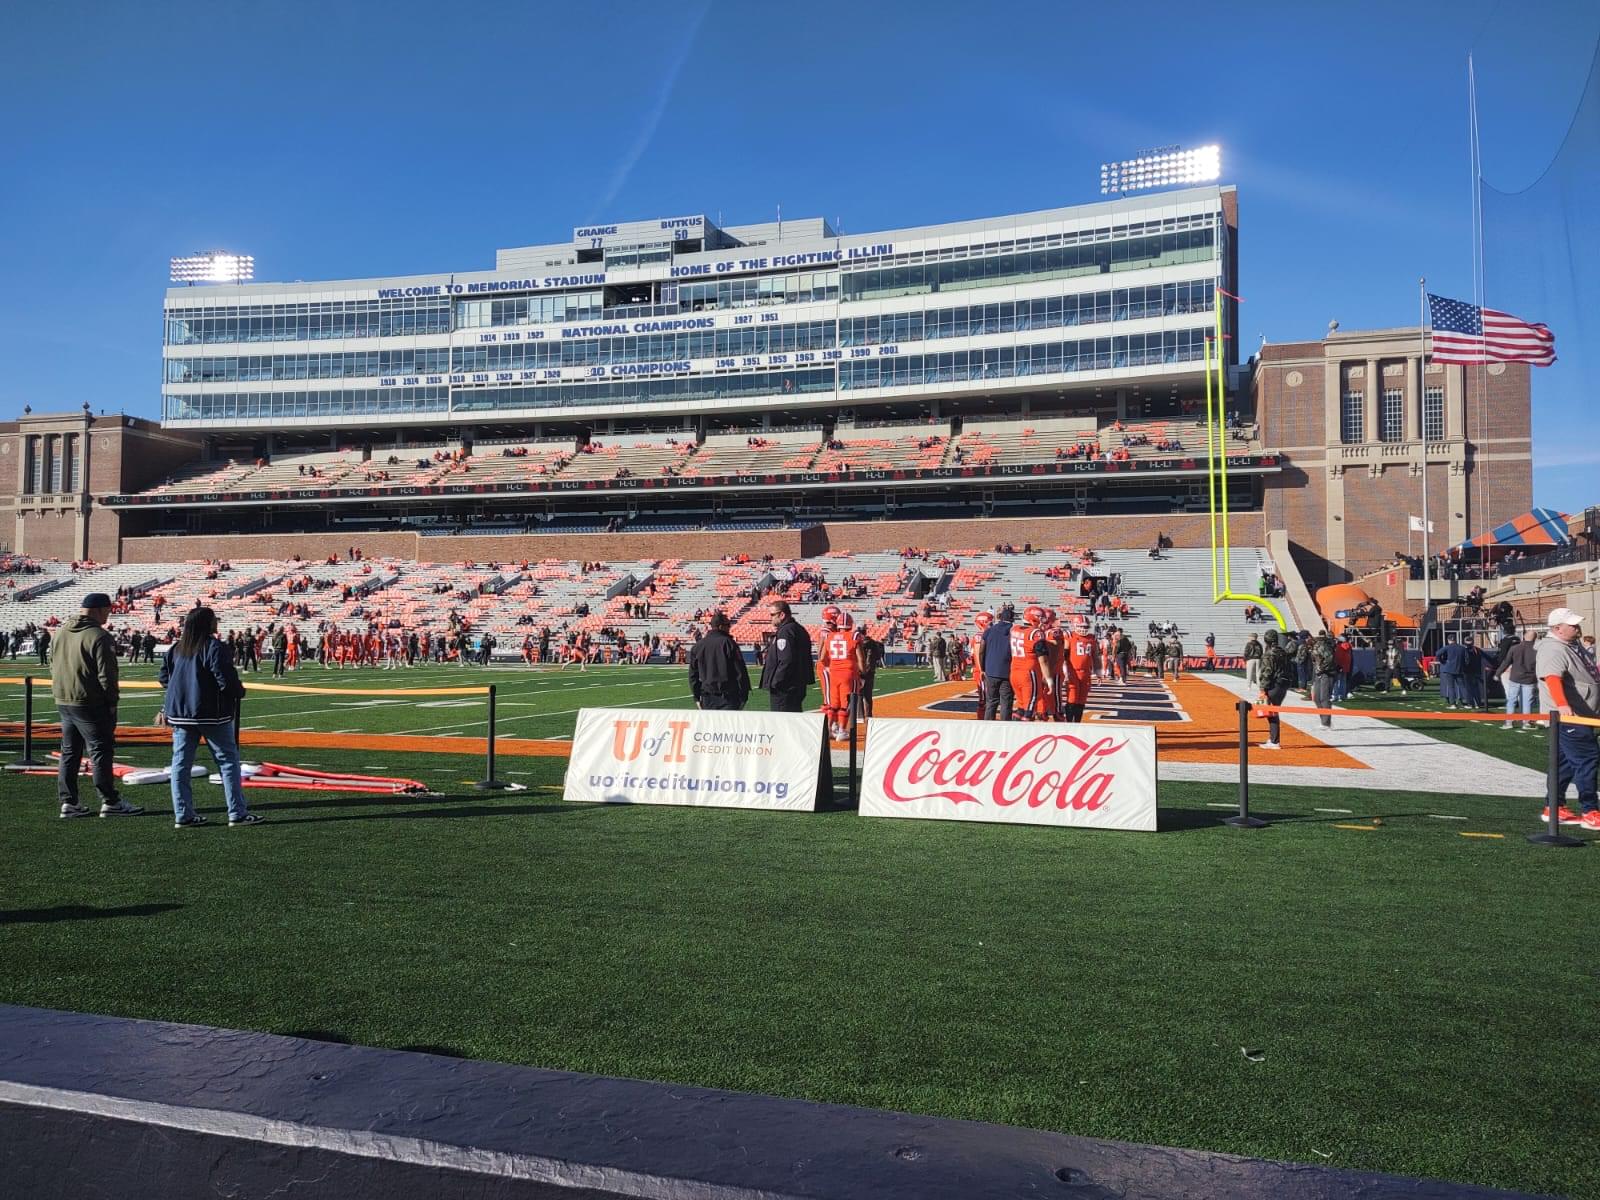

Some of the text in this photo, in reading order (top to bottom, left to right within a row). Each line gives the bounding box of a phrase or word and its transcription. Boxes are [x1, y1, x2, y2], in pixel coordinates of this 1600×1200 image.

[661, 218, 702, 229] BUTKUS
[577, 227, 617, 237] GRANGE
[675, 230, 688, 240] 50
[591, 238, 603, 248] 77
[670, 243, 893, 277] HOME OF THE FIGHTING ILLINI
[378, 274, 605, 298] WELCOME TO MEMORIAL STADIUM
[562, 318, 715, 337] NATIONAL CHAMPIONS
[850, 348, 871, 357] 1990
[879, 346, 899, 354] 2001
[611, 361, 691, 375] CHAMPIONS
[830, 640, 847, 659] 53
[693, 732, 774, 744] COMMUNITY
[691, 745, 773, 756] CREDIT UNION
[883, 731, 1130, 811] Coca-Cola
